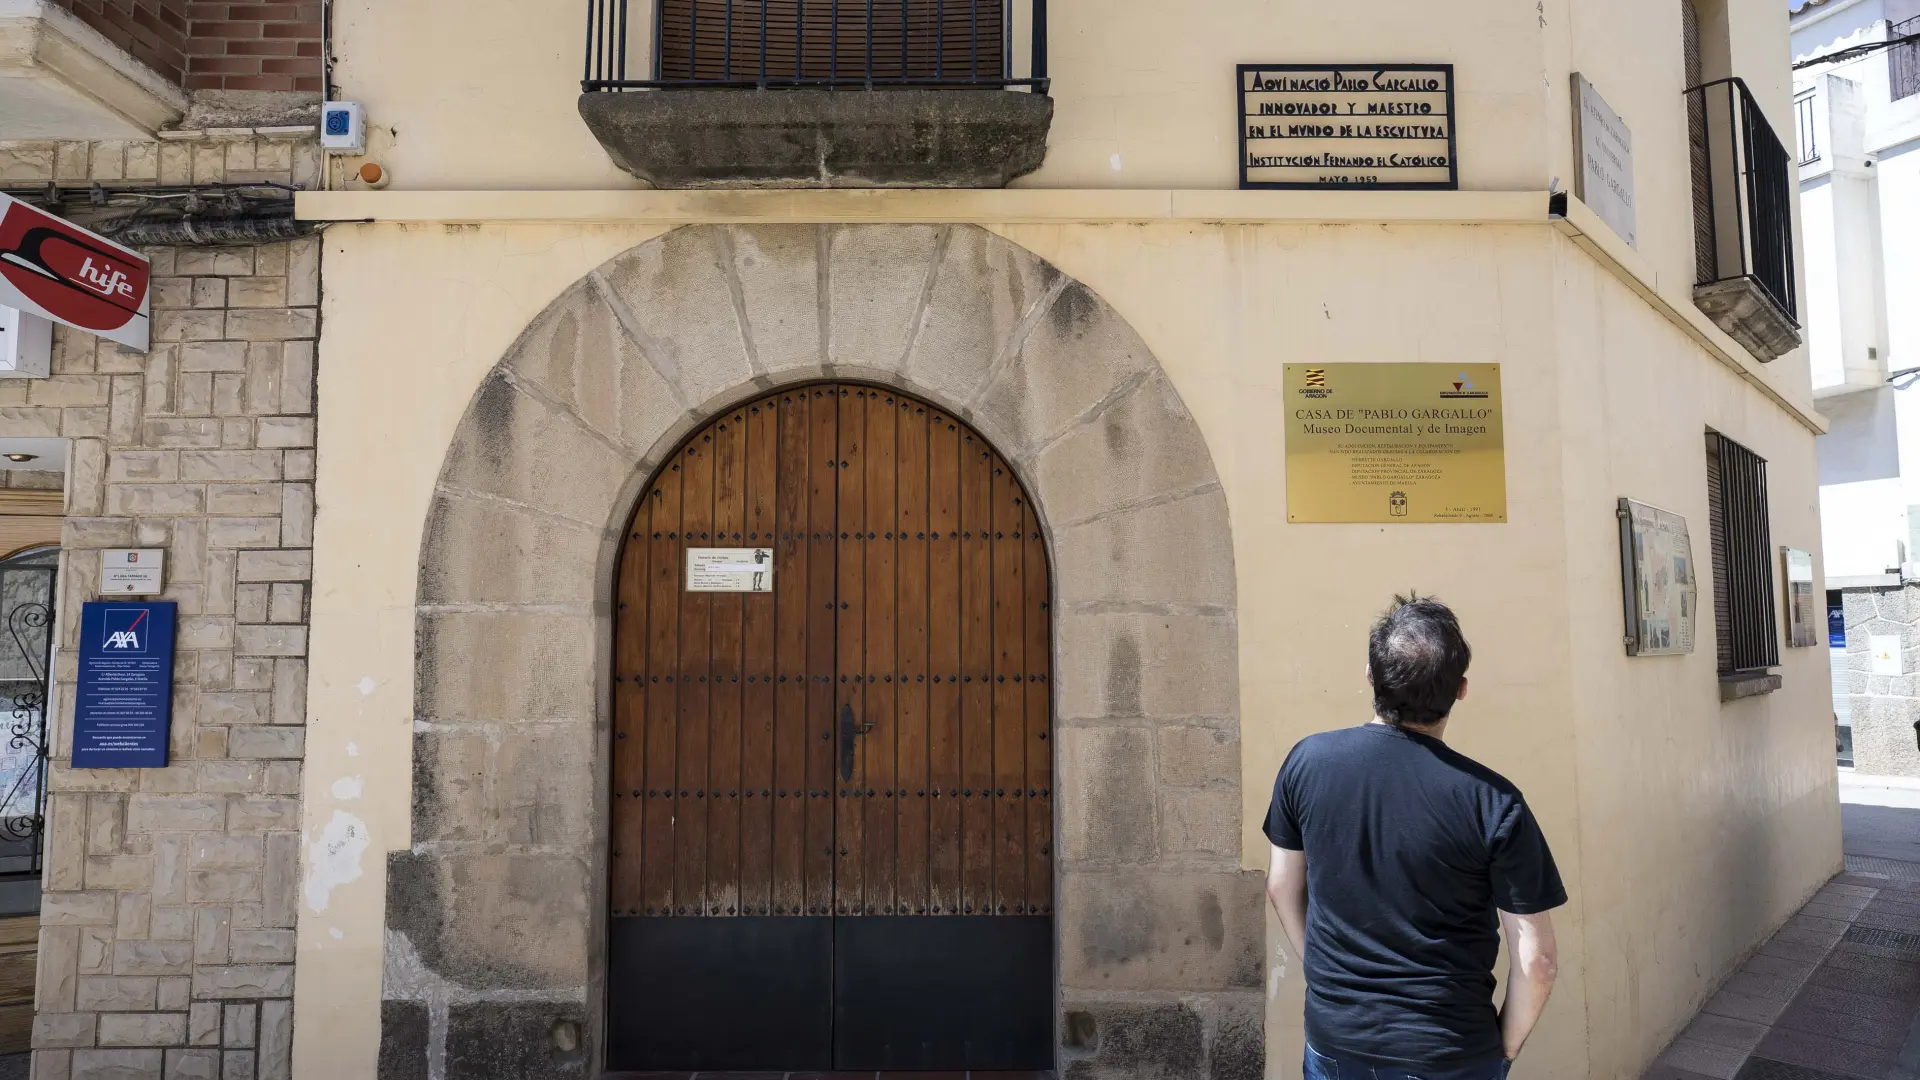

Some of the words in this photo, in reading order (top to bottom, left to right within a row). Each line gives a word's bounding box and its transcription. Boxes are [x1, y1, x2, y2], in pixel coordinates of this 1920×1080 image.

[1334, 70, 1369, 91] PABLO
[1372, 70, 1439, 91] GARGALLO
[1260, 102, 1338, 115] INNOVADOR
[1347, 102, 1356, 115] Y
[1367, 102, 1432, 115] MAESTRO
[1249, 125, 1265, 137] EN
[1270, 125, 1284, 137] EL
[1340, 125, 1352, 137] DE
[1356, 125, 1372, 137] LA
[1324, 152, 1374, 166] FERNANDO
[1377, 156, 1388, 166] EL
[1319, 175, 1349, 184] MAYO
[1354, 175, 1378, 184] 1959
[78, 256, 134, 296] hife
[1295, 409, 1333, 420] CASA
[1336, 409, 1354, 420] DE
[1358, 408, 1408, 420] "PABLO
[1411, 408, 1493, 420] GARGALLO"
[1303, 423, 1341, 434] Museo
[1345, 423, 1413, 434] Documental
[1417, 425, 1424, 436] y
[1427, 423, 1441, 434] de
[1445, 423, 1487, 436] Imagen
[103, 631, 140, 649] AXA
